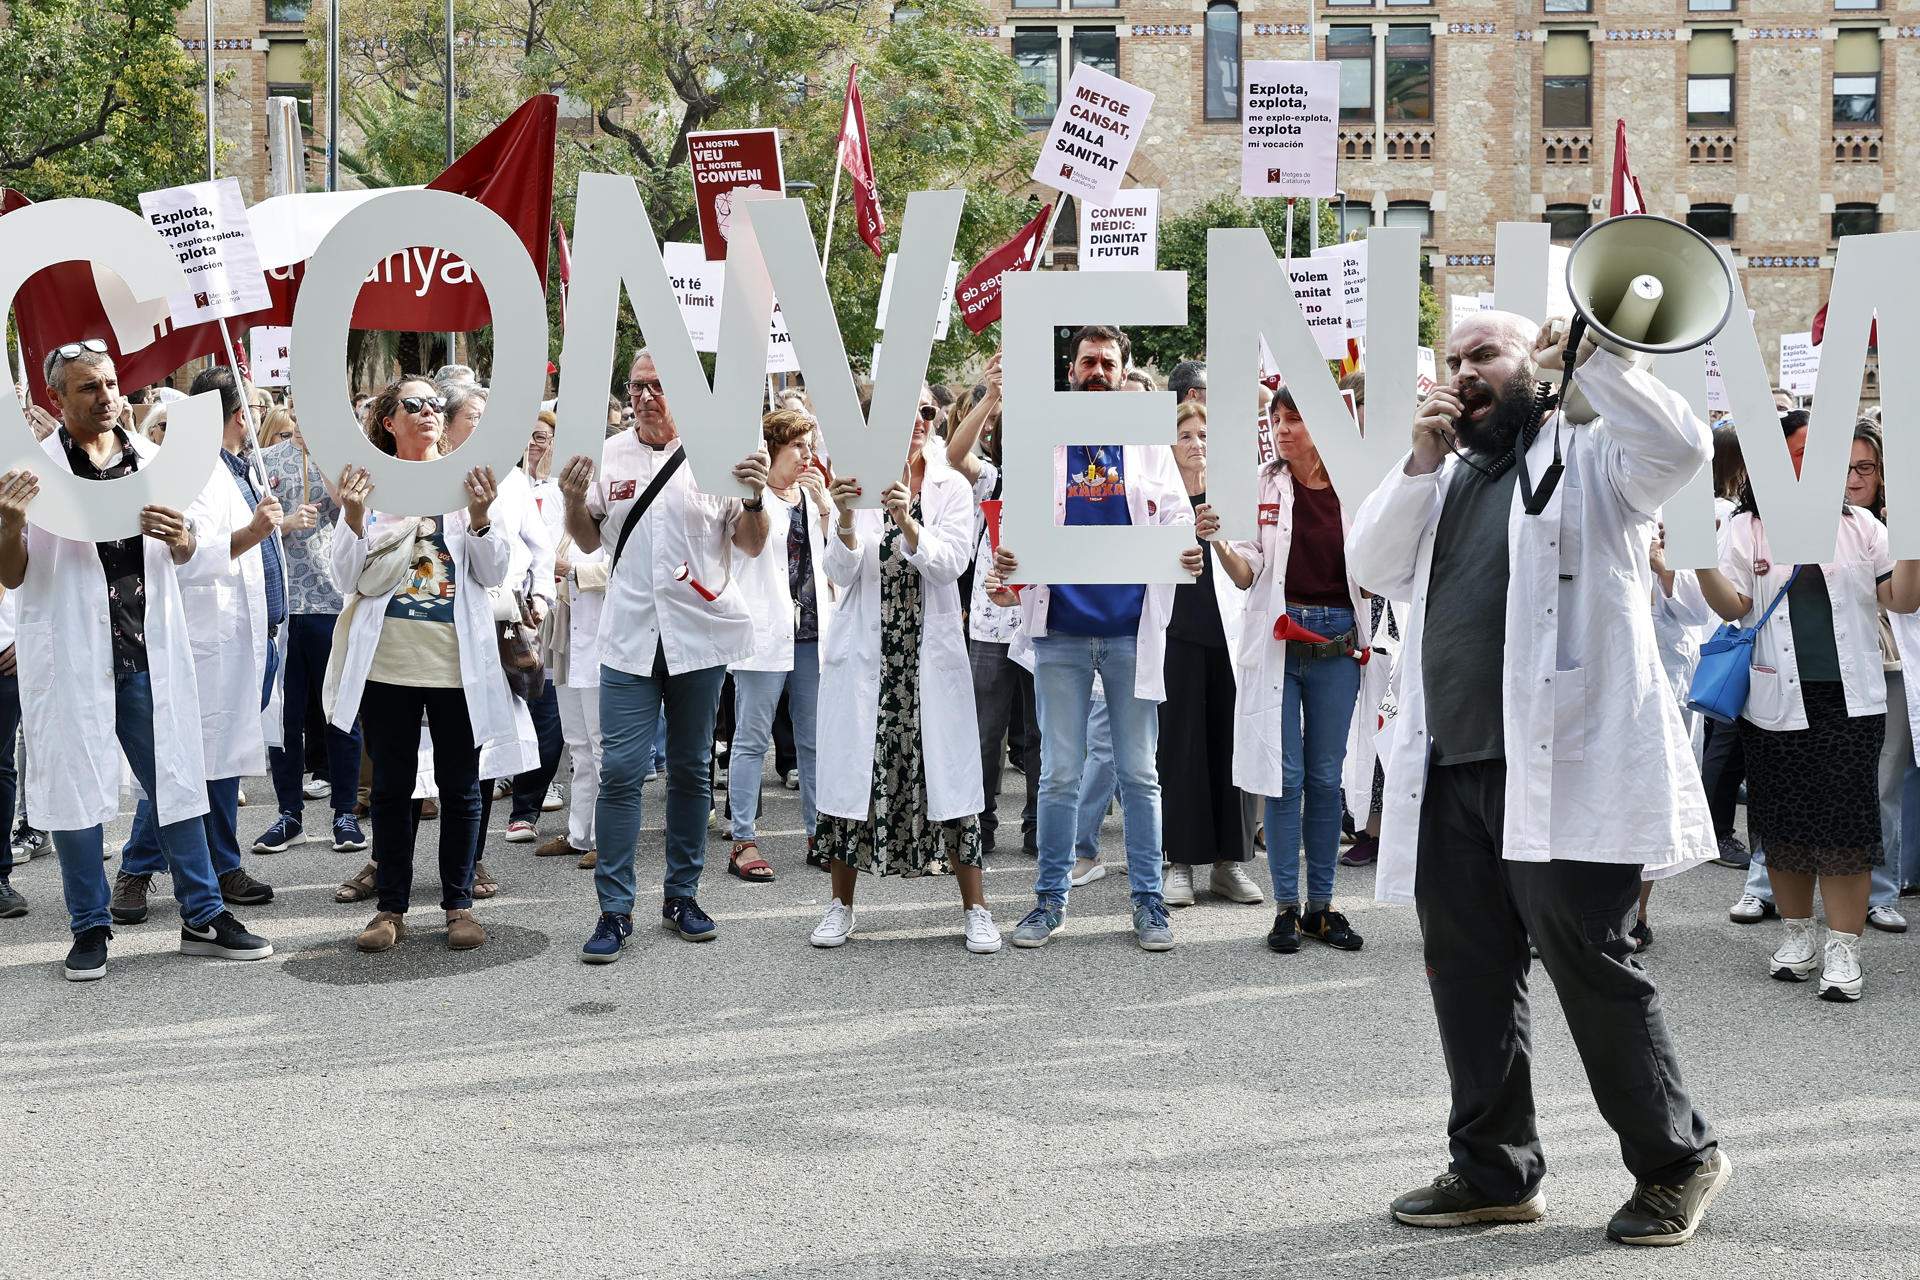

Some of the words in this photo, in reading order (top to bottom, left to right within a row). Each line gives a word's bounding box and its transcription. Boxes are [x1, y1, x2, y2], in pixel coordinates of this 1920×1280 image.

[1250, 84, 1308, 96] Explota,
[1076, 86, 1130, 117] METGE
[1249, 97, 1306, 110] explota,
[1069, 104, 1130, 140] CANSAT,
[1266, 114, 1332, 123] explo-explota,
[1062, 121, 1104, 147] MALA
[1249, 124, 1301, 136] explota
[706, 140, 739, 148] NOSTRA
[1263, 140, 1304, 148] vocación
[694, 149, 723, 161] VEU
[1056, 139, 1118, 171] SANITAT
[709, 161, 742, 169] NOSTRE
[698, 169, 762, 183] CONVENI
[151, 206, 213, 225] Explota,
[1091, 207, 1147, 218] CONVENI
[1090, 219, 1136, 231] MÈDIC:
[177, 230, 244, 249] explo-explota,
[1090, 233, 1147, 244] DIGNITAT
[176, 246, 216, 264] plota
[1090, 248, 1094, 257] I
[1097, 246, 1139, 257] FUTUR
[1290, 272, 1328, 282] Volem
[689, 278, 702, 289] té
[1294, 286, 1331, 298] anitat
[685, 294, 714, 307] límit
[1306, 305, 1321, 313] no
